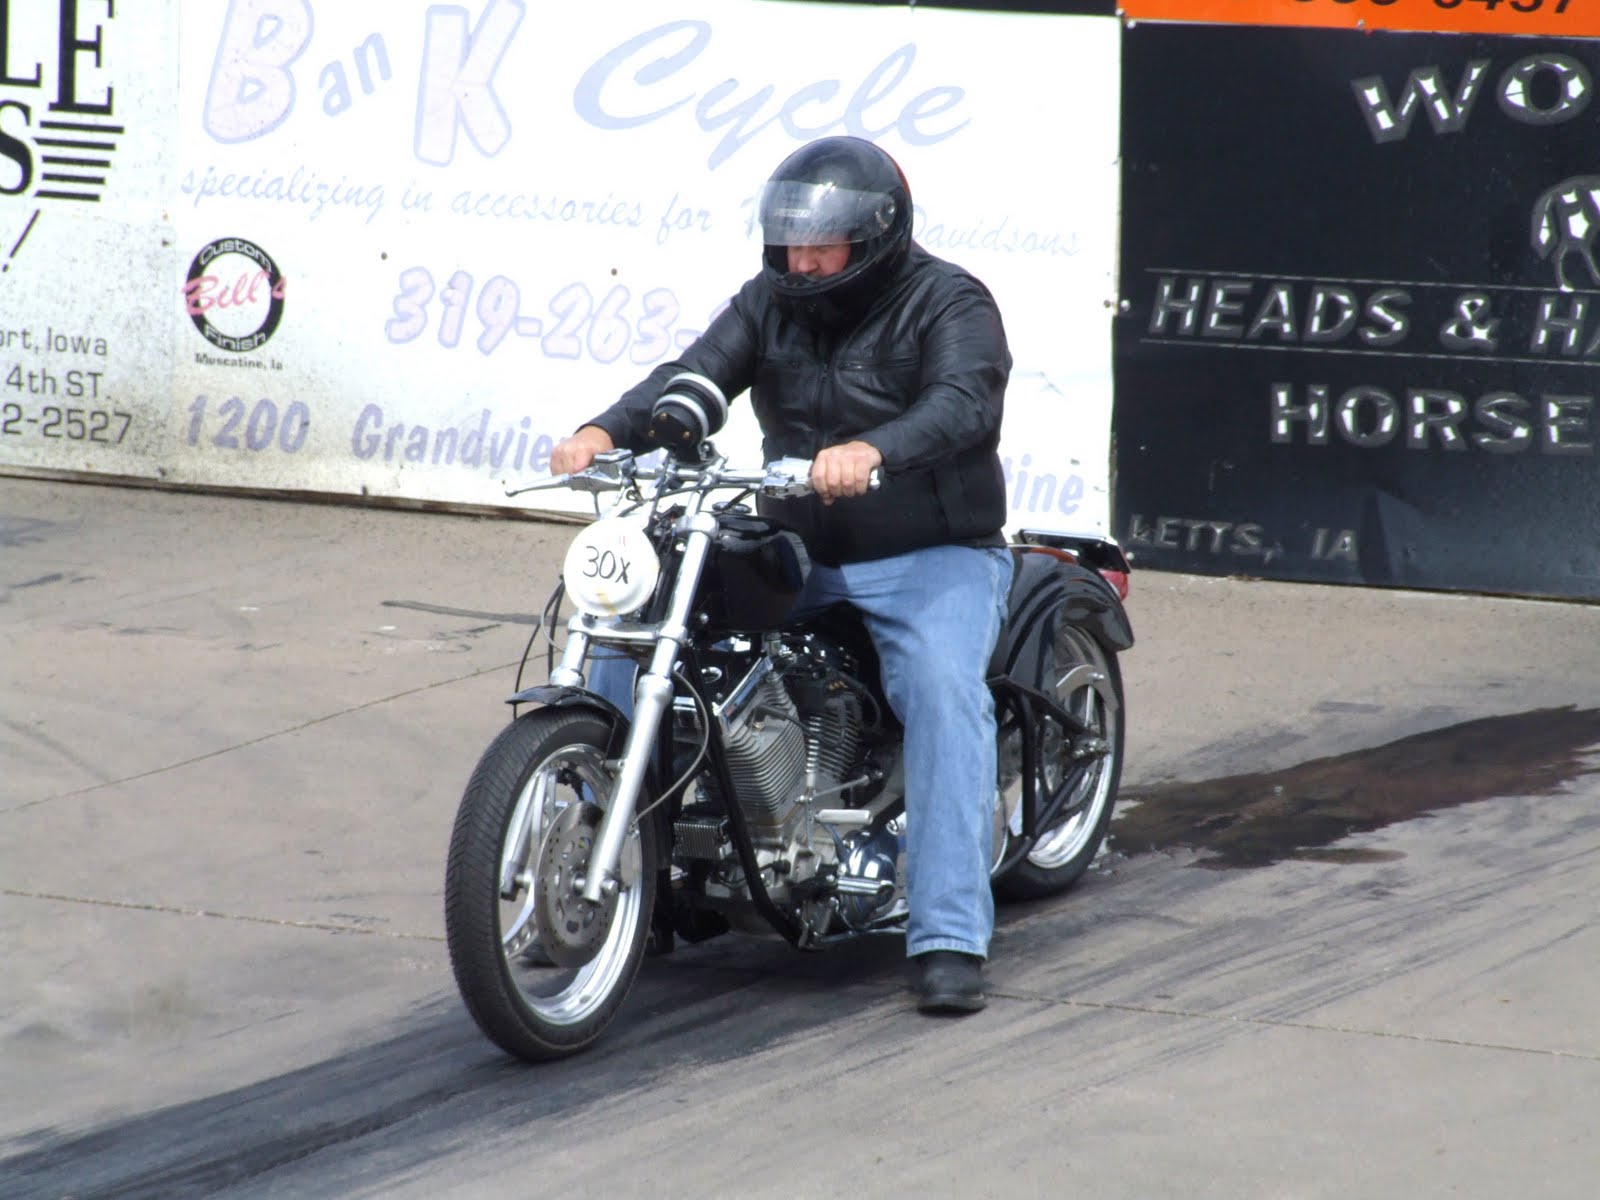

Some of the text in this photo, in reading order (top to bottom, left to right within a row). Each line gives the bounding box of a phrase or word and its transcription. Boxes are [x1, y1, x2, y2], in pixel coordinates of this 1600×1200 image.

[573, 19, 972, 171] Cycle
[1350, 53, 1592, 144] WO
[180, 165, 386, 224] specializing
[401, 178, 434, 212] in
[450, 186, 645, 228] accessories
[655, 193, 714, 246] for
[200, 240, 272, 273] Custom
[46, 327, 108, 356] Iowa
[204, 323, 267, 352] Finish
[384, 266, 731, 365] 319-263-
[1148, 276, 1600, 356] HEADS & H
[6, 364, 57, 395] 4th
[2, 403, 132, 444] 2-2527
[184, 394, 568, 473] 1200 Grandvie
[1270, 382, 1594, 456] HORSE
[1311, 527, 1361, 562] IA
